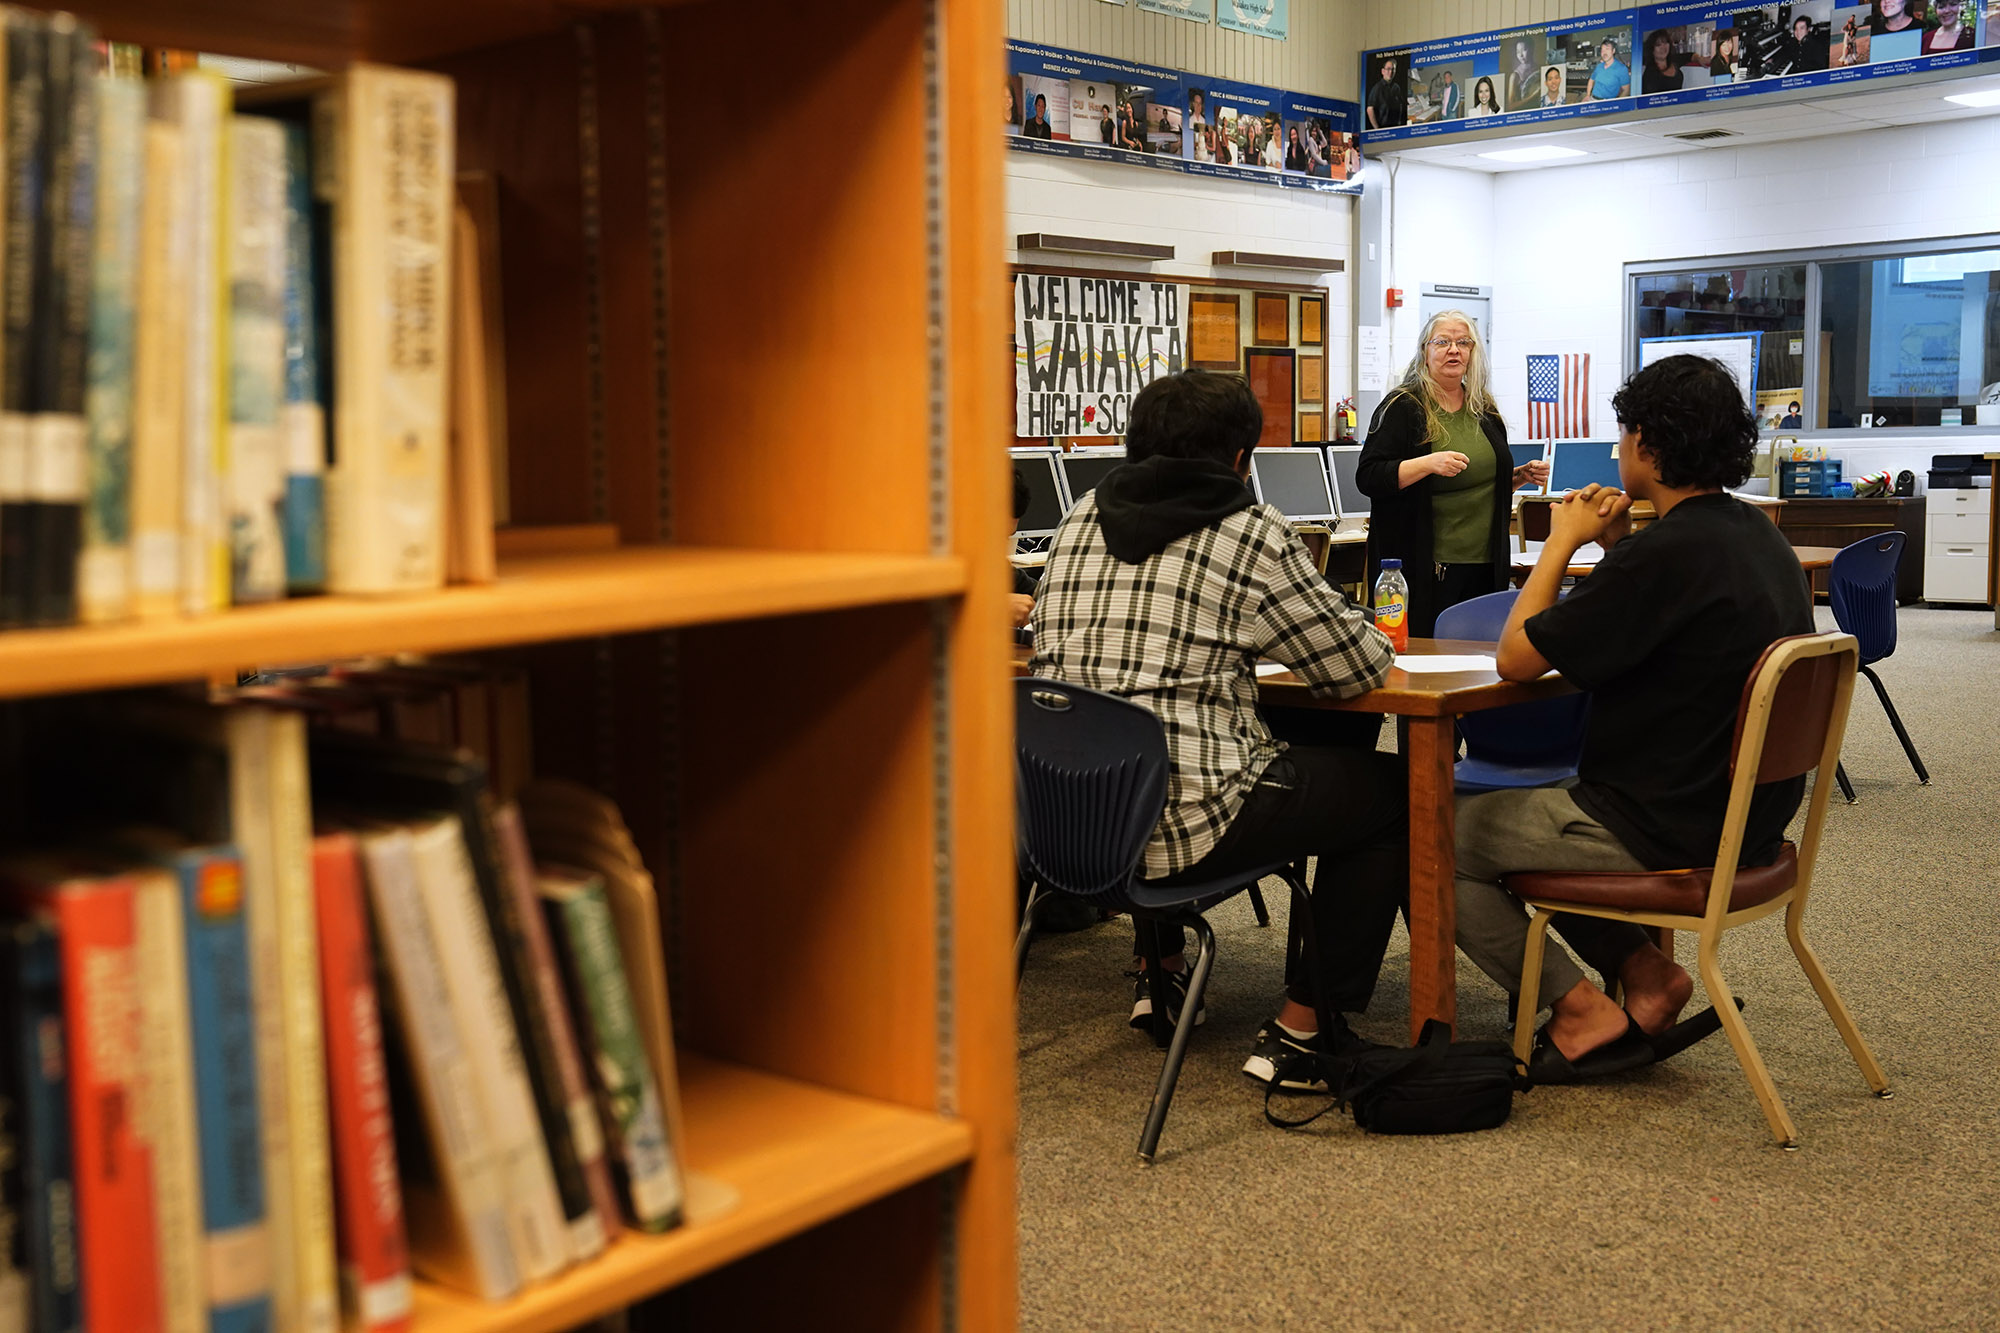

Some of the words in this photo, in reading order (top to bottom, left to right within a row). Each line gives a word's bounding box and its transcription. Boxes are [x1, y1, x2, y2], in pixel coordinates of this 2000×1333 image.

[1724, 2, 1779, 16] COMMUNICATIONS
[1463, 36, 1488, 46] Wonderful
[1493, 30, 1526, 41] Extraordinary
[1526, 28, 1544, 38] People
[1575, 20, 1588, 30] High
[1588, 17, 1606, 26] School
[1431, 49, 1476, 62] COMMUNICATIONS
[1476, 45, 1502, 55] ACADEMY
[1042, 63, 1061, 72] BUSINESS
[1061, 66, 1081, 75] ACADEMY
[1074, 55, 1092, 65] Wonderful
[1097, 60, 1122, 71] Extraordinary
[1122, 65, 1136, 73] People
[1157, 71, 1165, 79] High
[1165, 73, 1178, 81] School
[1072, 98, 1084, 110] CU
[1253, 98, 1270, 107] ACADEMY
[1332, 110, 1347, 119] ACADEMY
[1022, 275, 1141, 325] WELCOME
[1151, 283, 1177, 326] TO
[1028, 392, 1081, 436] HIGH
